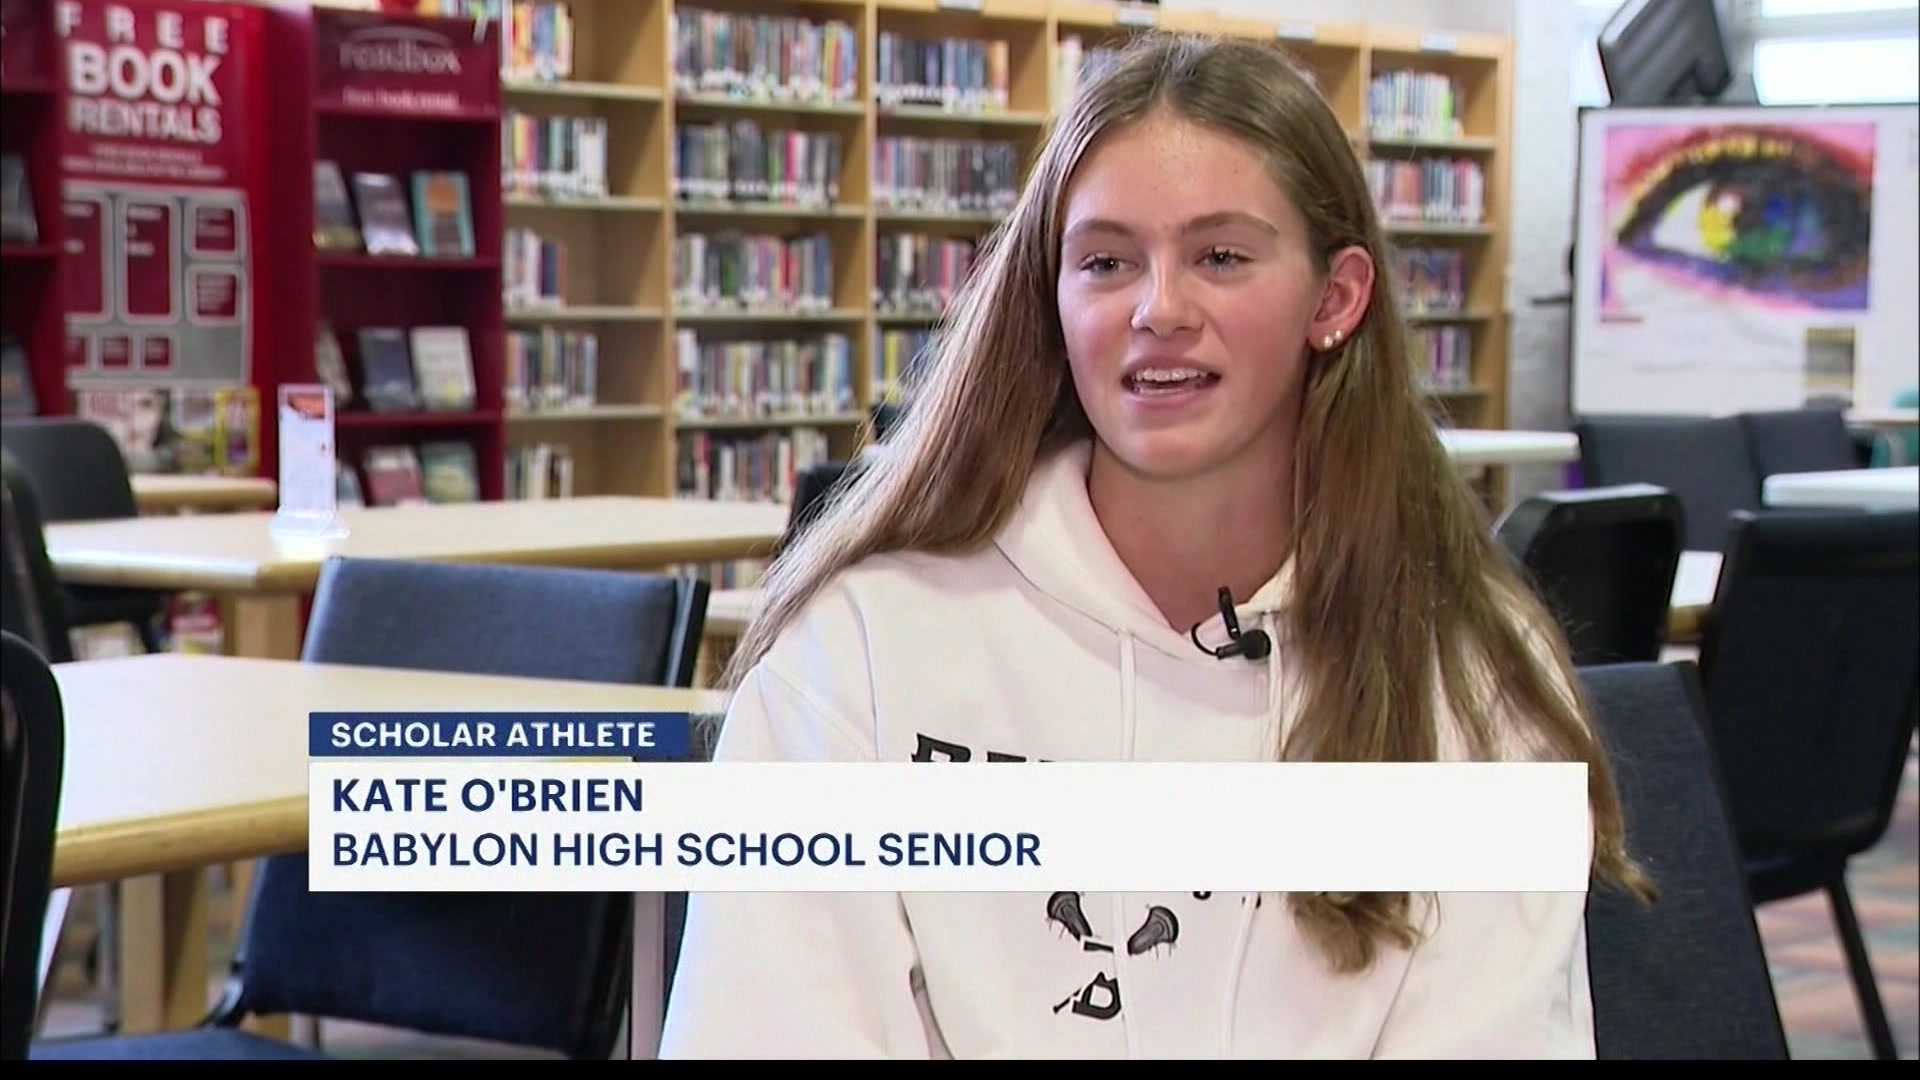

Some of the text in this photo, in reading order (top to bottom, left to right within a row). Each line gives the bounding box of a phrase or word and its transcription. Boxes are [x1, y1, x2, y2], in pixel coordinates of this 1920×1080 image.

[55, 2, 229, 54] FREE
[68, 41, 222, 106] BOOK
[67, 97, 222, 143] RENTALS
